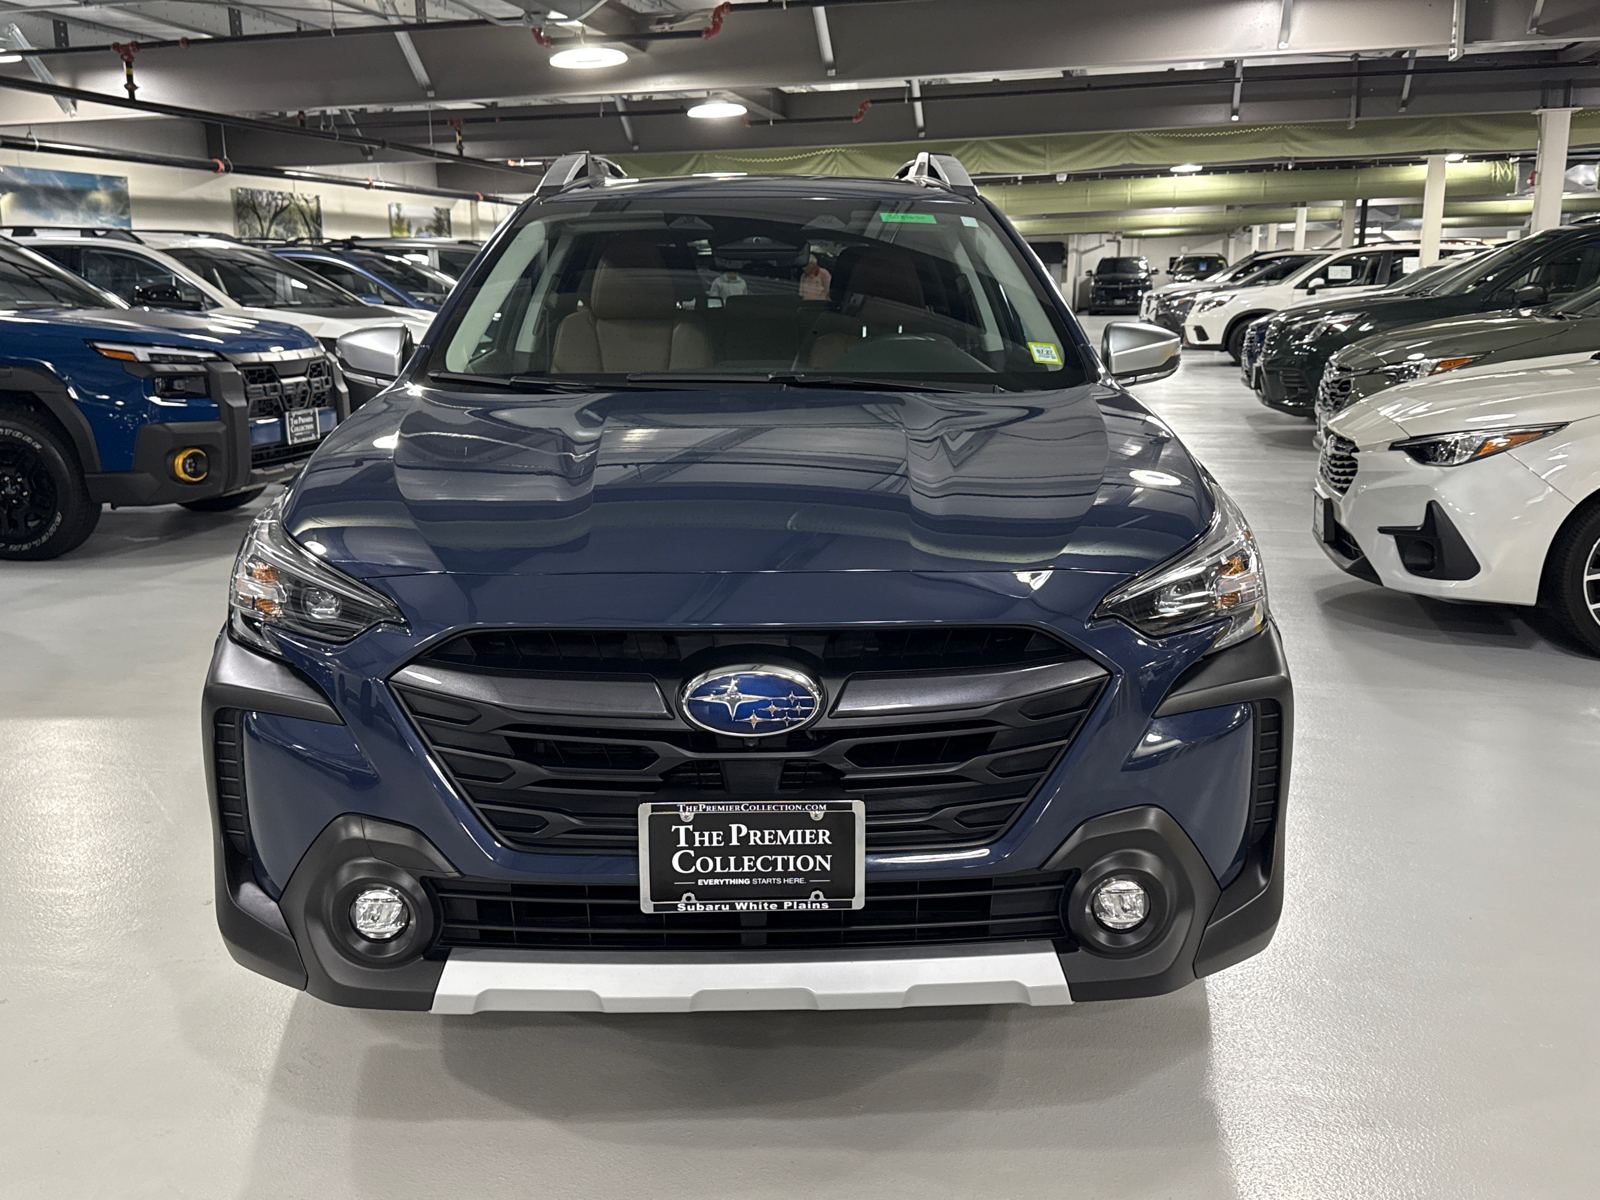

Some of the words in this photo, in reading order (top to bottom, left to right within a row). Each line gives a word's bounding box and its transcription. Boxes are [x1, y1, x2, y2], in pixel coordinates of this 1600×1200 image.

[671, 825, 725, 848] THE
[729, 823, 833, 846] PREMIER
[671, 849, 833, 874] COLLECTION
[698, 878, 751, 886] EVERYTHING
[752, 877, 782, 885] STARTS
[783, 877, 807, 885] HERE.
[677, 902, 731, 912] Subaru
[735, 901, 779, 911] White
[783, 900, 829, 910] Plains
